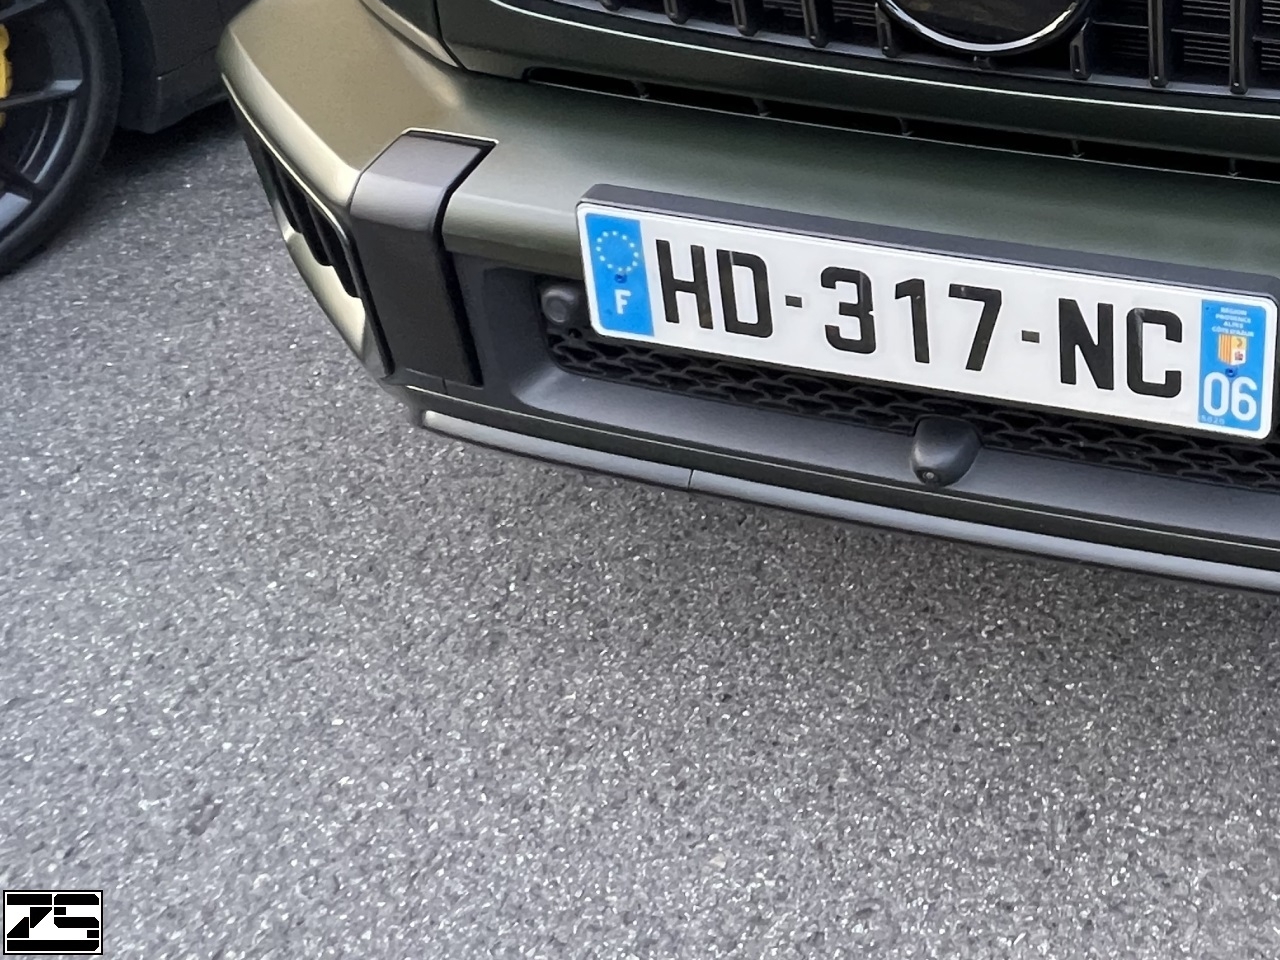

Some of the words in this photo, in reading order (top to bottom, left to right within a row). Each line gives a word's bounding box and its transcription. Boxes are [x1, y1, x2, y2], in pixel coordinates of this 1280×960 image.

[613, 289, 632, 315] F
[654, 239, 1185, 400] HD-317-NC
[1203, 371, 1258, 421] 06
